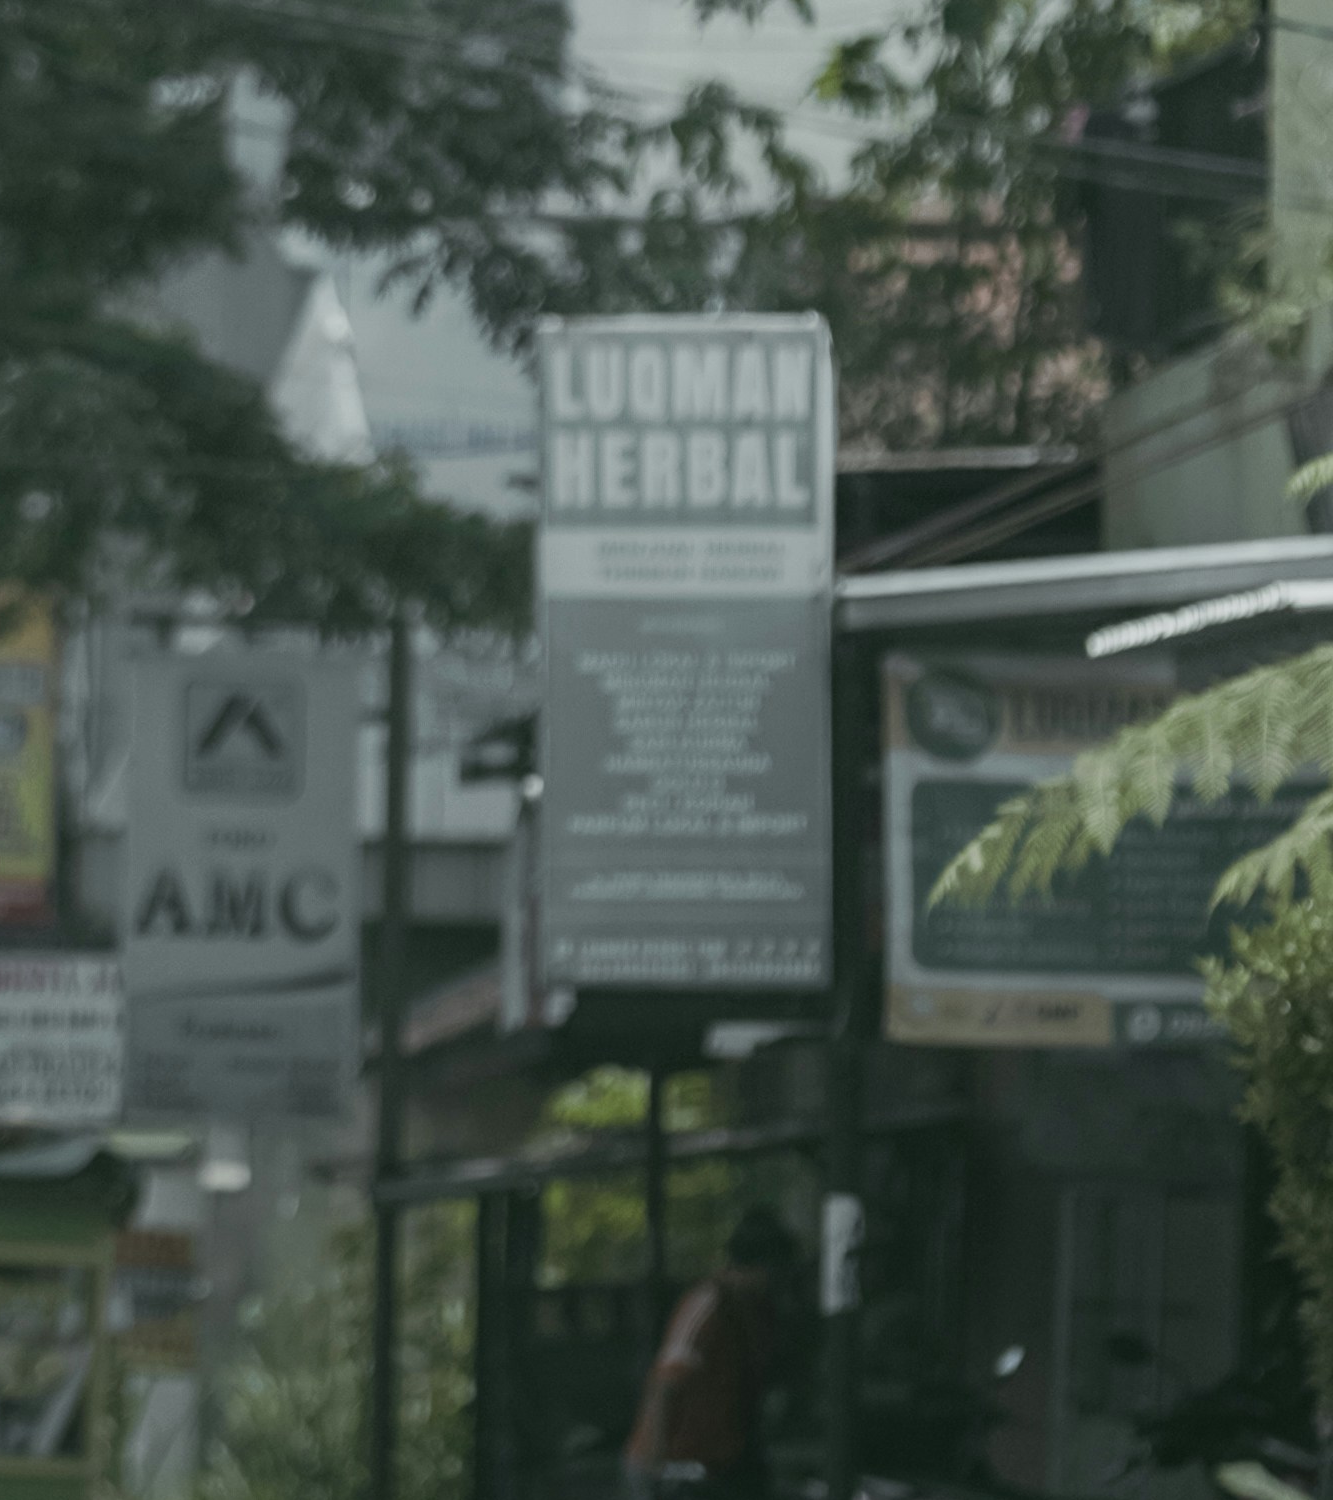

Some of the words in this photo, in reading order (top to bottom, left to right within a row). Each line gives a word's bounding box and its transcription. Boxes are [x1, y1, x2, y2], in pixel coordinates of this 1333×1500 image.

[552, 343, 811, 423] LUQMAN
[552, 429, 811, 510] HERBAL
[132, 867, 342, 943] AMC
